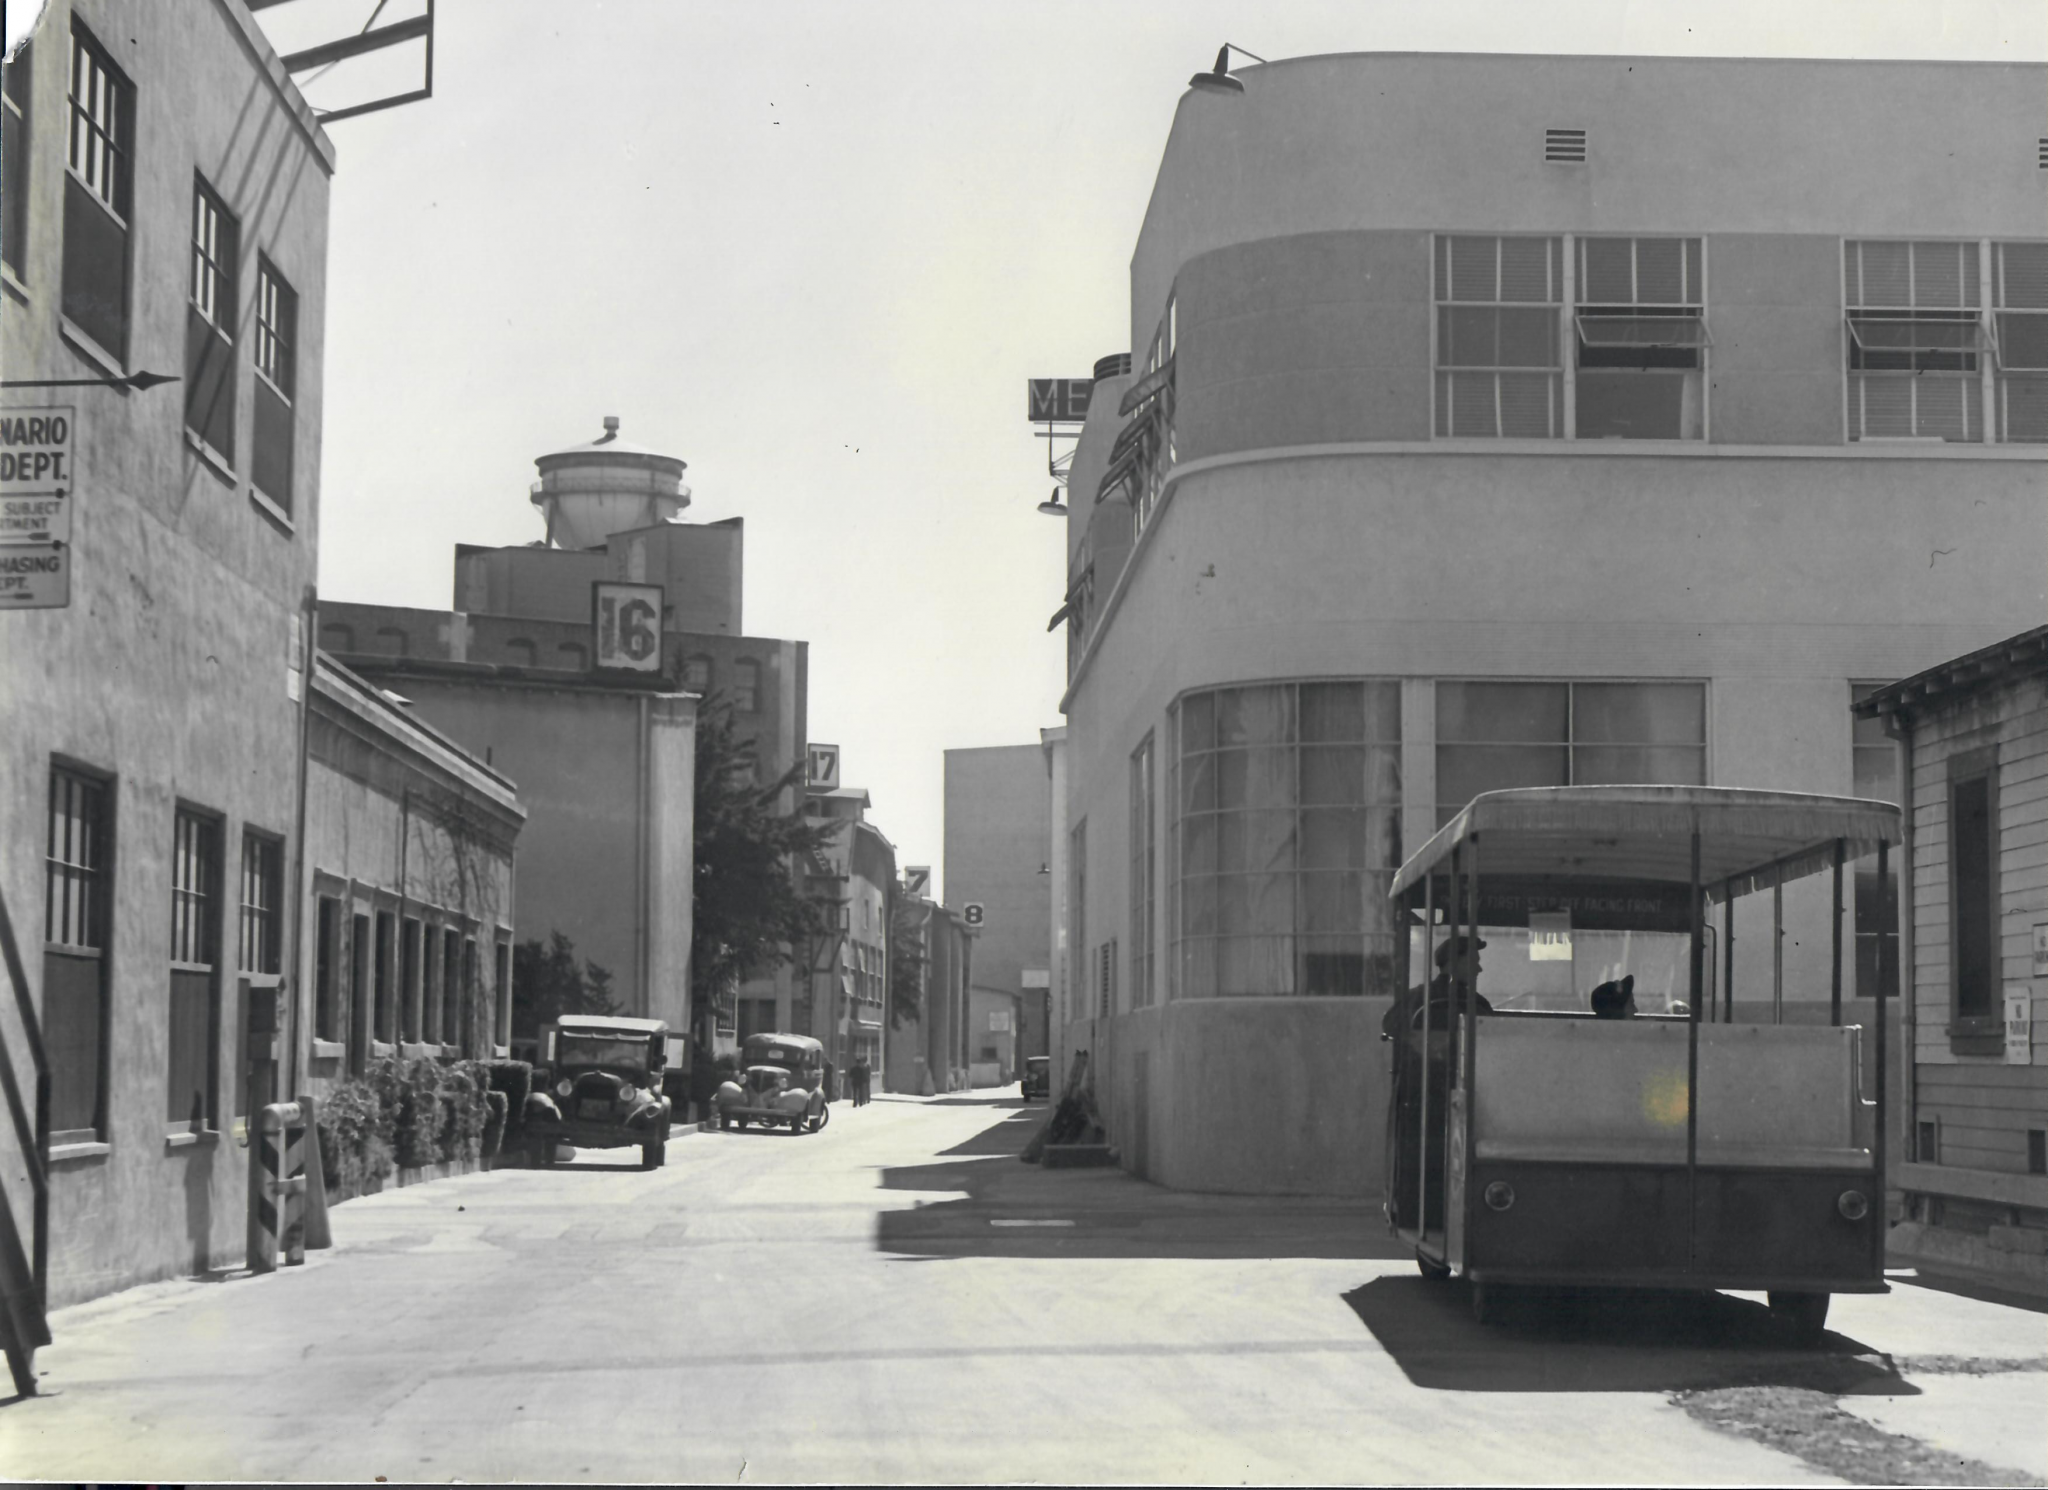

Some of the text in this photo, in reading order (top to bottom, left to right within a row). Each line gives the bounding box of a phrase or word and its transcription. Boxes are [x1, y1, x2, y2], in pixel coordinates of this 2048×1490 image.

[1028, 378, 1090, 417] ME
[0, 416, 67, 446] NARIO
[0, 451, 68, 482] DEPT.
[4, 501, 61, 516] SUBJECT
[601, 596, 656, 661] 16
[811, 751, 836, 781] 17
[908, 870, 929, 893] 7
[964, 904, 983, 924] 8
[1584, 897, 1624, 912] FACING
[1627, 898, 1662, 913] FRONT
